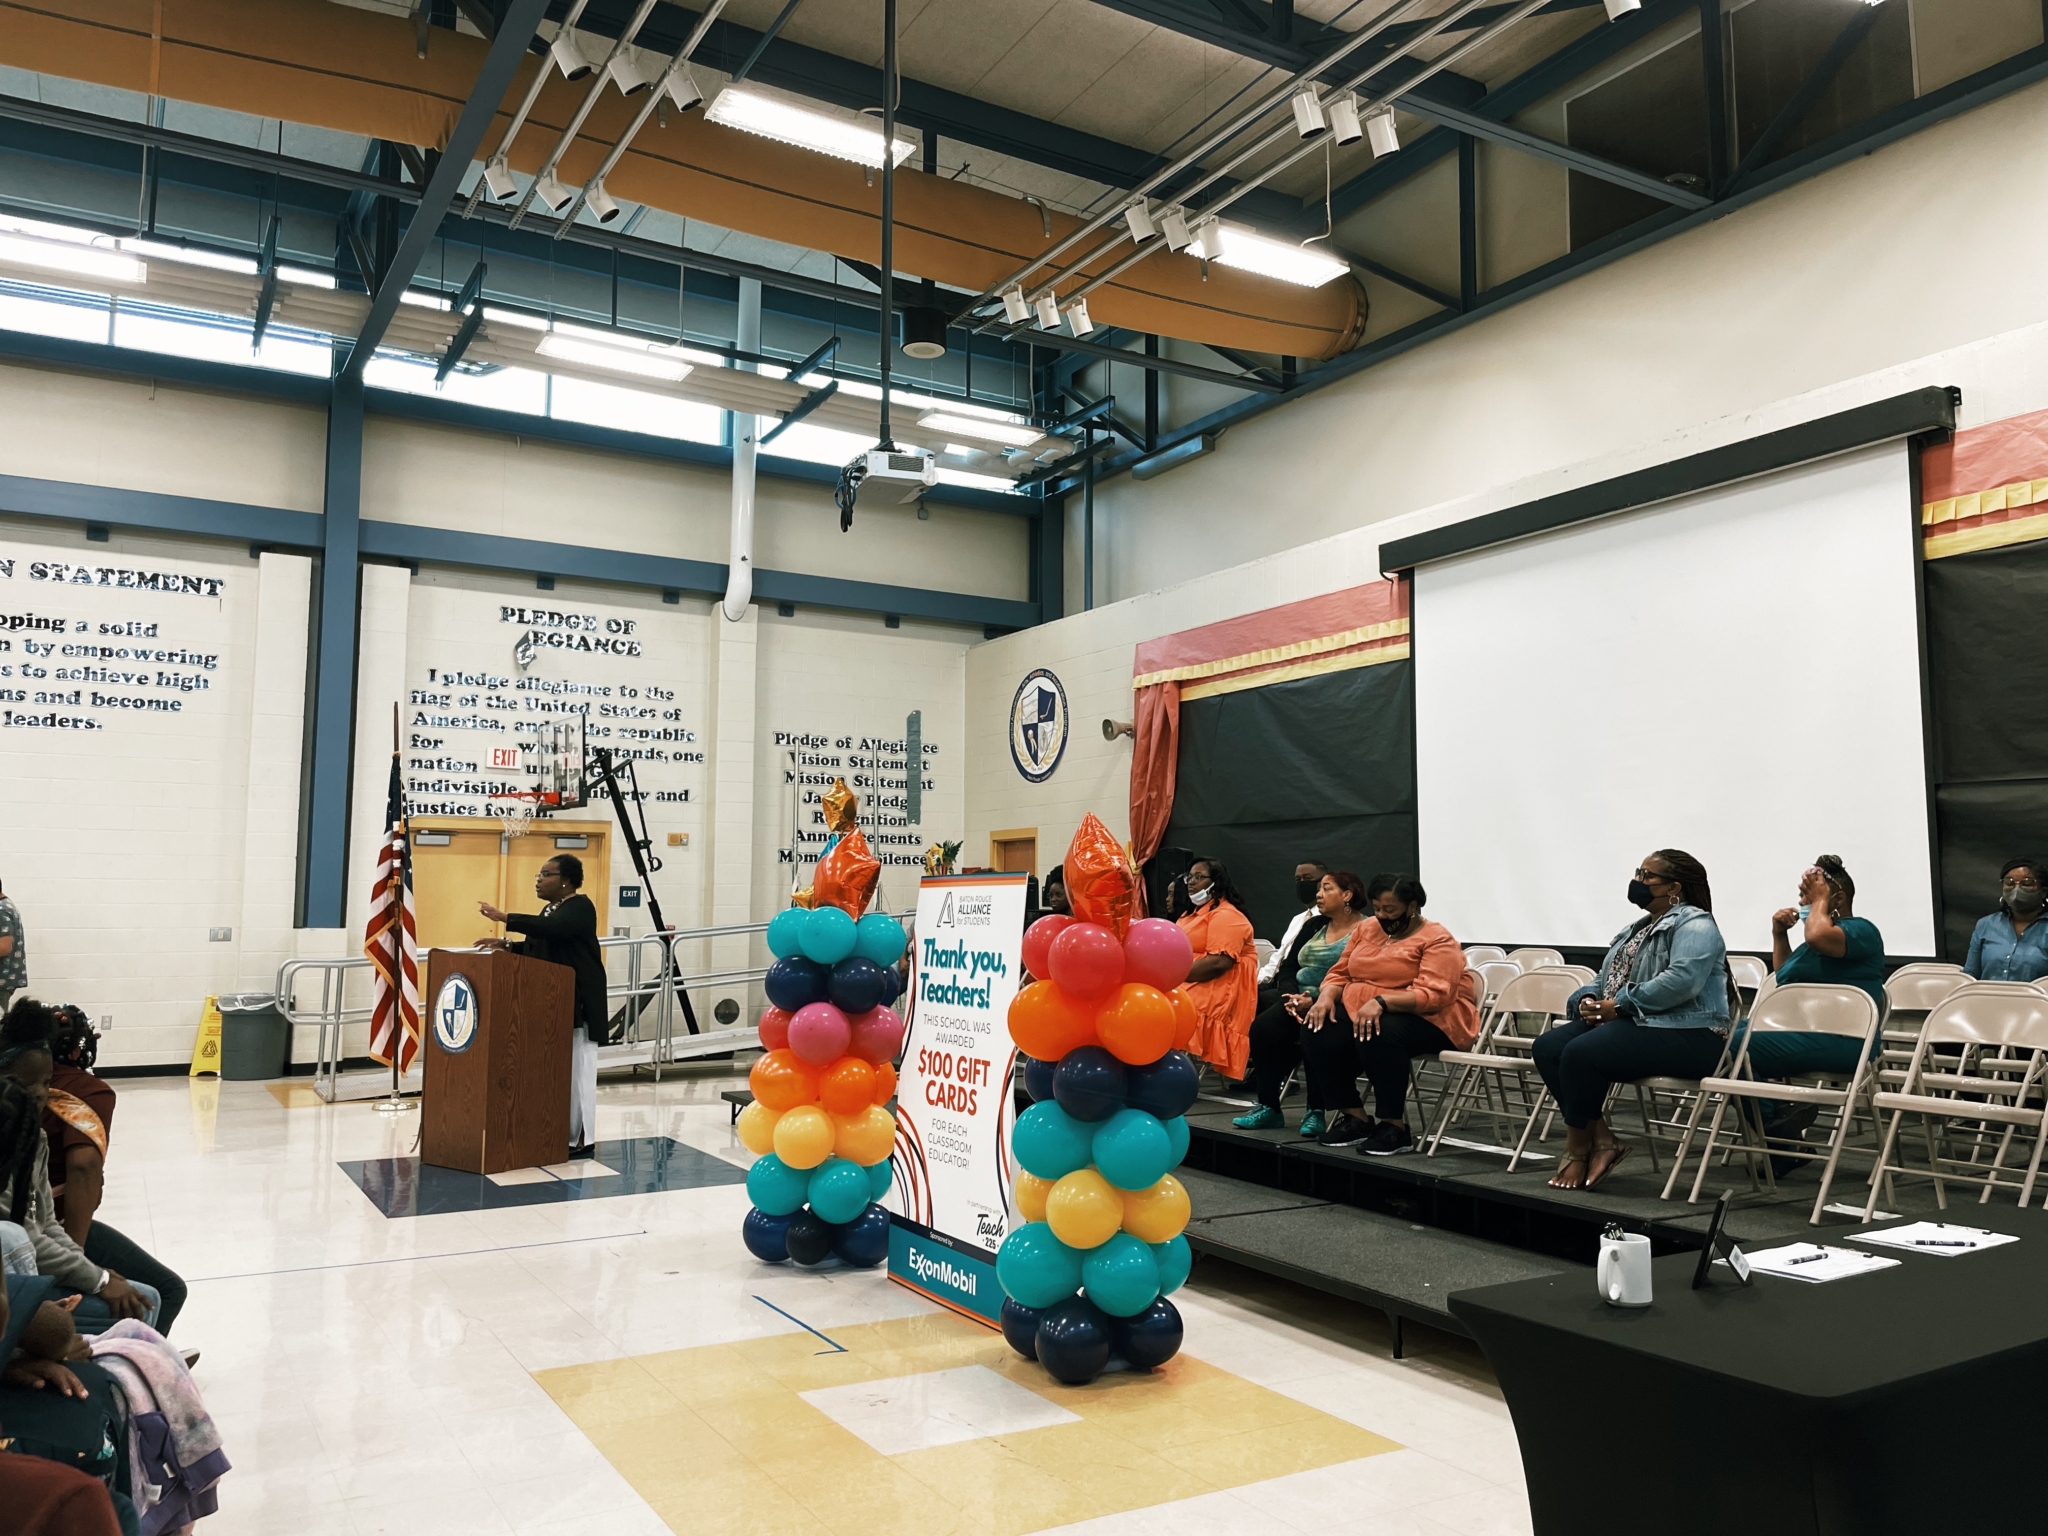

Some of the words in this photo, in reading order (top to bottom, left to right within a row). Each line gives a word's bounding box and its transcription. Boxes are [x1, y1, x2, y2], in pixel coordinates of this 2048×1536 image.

[29, 561, 224, 597] STATEMENT
[75, 621, 88, 633] a
[99, 621, 158, 637] solid
[500, 606, 597, 632] PLEDGE
[606, 618, 637, 635] OF
[23, 638, 56, 658] by
[62, 643, 218, 669] empowering
[531, 630, 642, 657] EGIANCE
[21, 663, 47, 679] to
[55, 666, 149, 685] achieve
[156, 671, 210, 691] high
[428, 668, 437, 682] I
[442, 671, 509, 690] pledge
[516, 678, 612, 695] allegiance
[619, 685, 638, 698] to
[645, 686, 674, 700] the
[35, 690, 81, 705] and
[91, 692, 182, 712] become
[410, 690, 451, 707] flag
[459, 694, 478, 707] of
[485, 696, 518, 710] the
[524, 697, 591, 714] United
[600, 702, 656, 719] States
[663, 709, 682, 721] of
[4, 711, 103, 730] leaders.
[412, 712, 506, 733] America,
[618, 728, 696, 742] republic
[410, 734, 443, 748] for
[673, 751, 705, 763] one
[775, 732, 828, 749] Pledge
[835, 737, 852, 749] of
[858, 738, 938, 754] Alegice
[409, 758, 478, 773] nation
[493, 749, 517, 767] EXIT
[848, 756, 929, 771] Statemt
[590, 765, 630, 783] Gd,
[785, 771, 845, 785] Missio
[854, 775, 934, 790] Sttemnt
[656, 791, 690, 802] and
[866, 794, 908, 811] Pledg
[404, 799, 478, 817] justice
[485, 803, 515, 817] for
[622, 890, 638, 898] EXIT
[957, 904, 992, 915] ALLIANCE
[964, 917, 991, 926] STUDENTS
[923, 937, 969, 971] Thank
[969, 950, 1006, 980] you,
[920, 972, 991, 1010] Teachers!
[923, 1013, 939, 1027] THIS
[940, 1016, 971, 1032] SCHOOL
[973, 1020, 991, 1035] WAS
[935, 1032, 975, 1049] AWARDED
[917, 1044, 953, 1079] $100
[956, 1055, 991, 1088] GIFT
[925, 1079, 978, 1117] CARDS
[931, 1118, 946, 1131] FOR
[947, 1122, 968, 1137] EACH
[927, 1132, 972, 1155] CLASSROOM
[928, 1147, 970, 1170] EDUCATOR!
[976, 1213, 1005, 1238] Teach
[929, 1231, 948, 1244] Sponsored
[984, 1237, 997, 1250] 225
[908, 1246, 977, 1297] ExxonMobil
